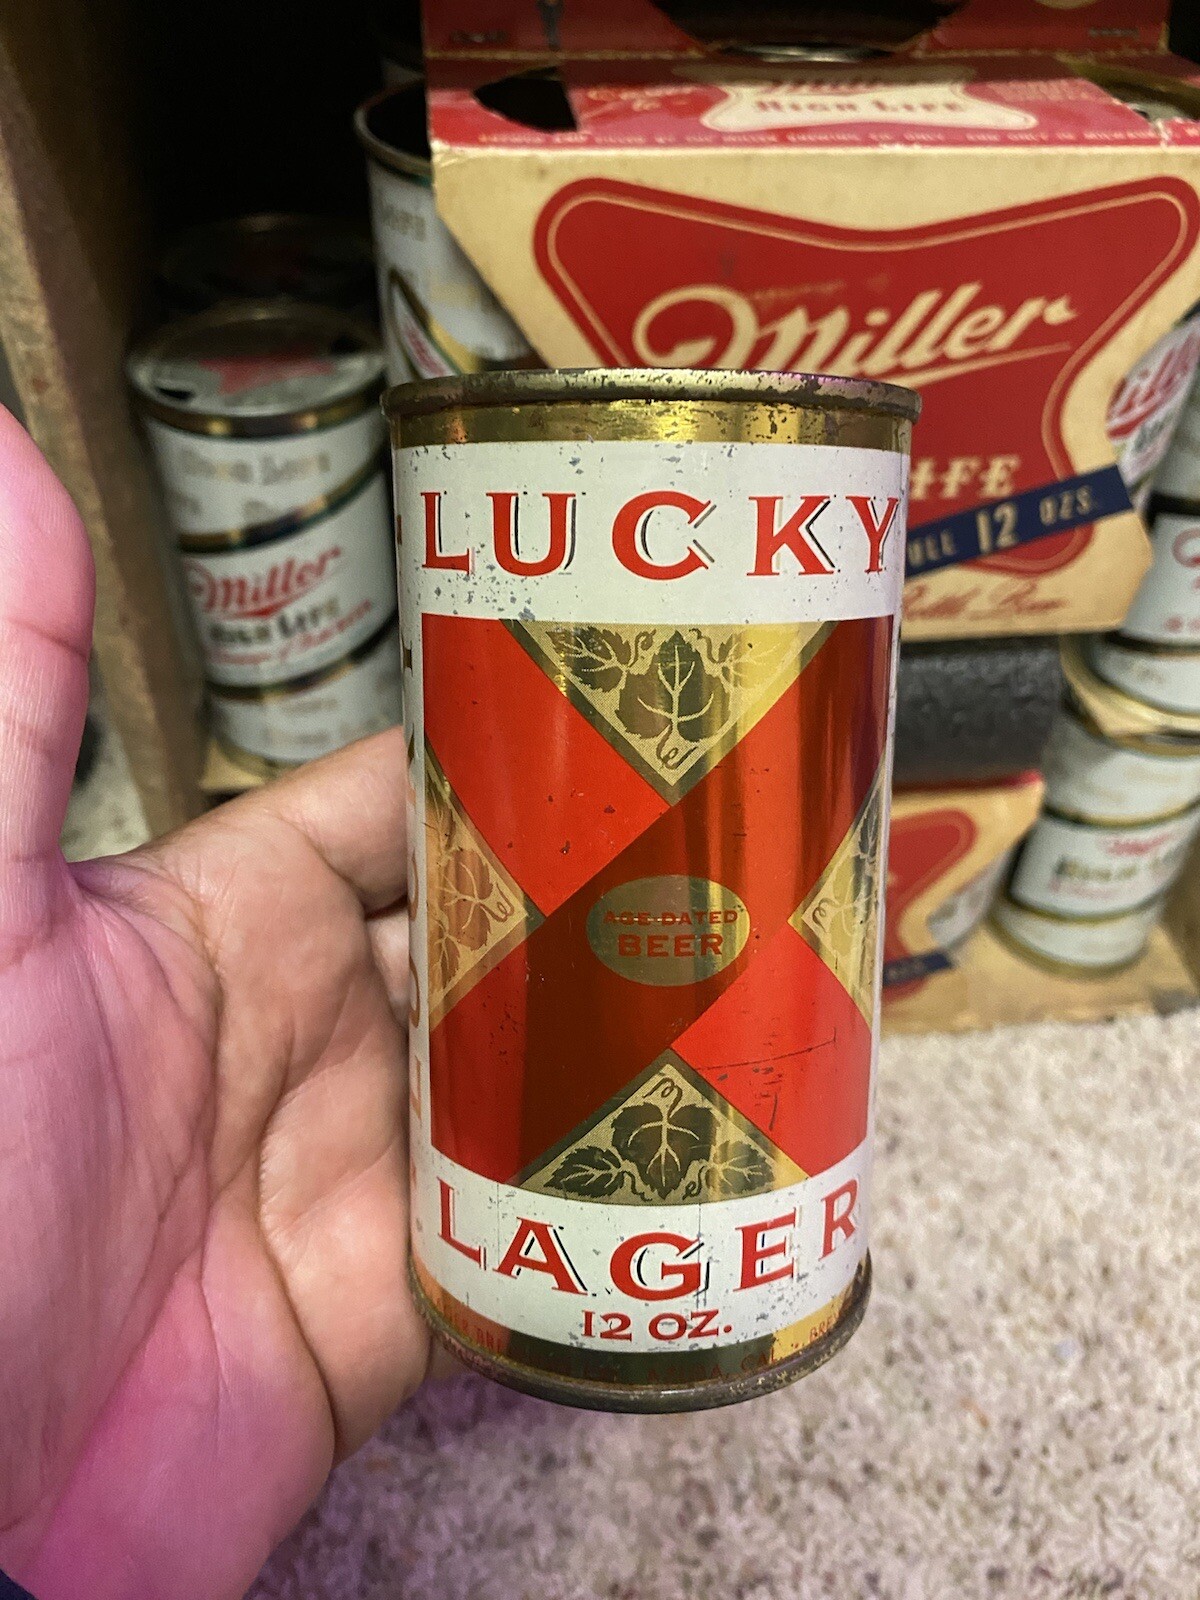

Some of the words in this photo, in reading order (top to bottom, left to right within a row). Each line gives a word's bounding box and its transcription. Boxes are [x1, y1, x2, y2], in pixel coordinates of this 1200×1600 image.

[632, 281, 1078, 378] Miller
[419, 489, 900, 580] LUCKY
[907, 531, 956, 567] ULL
[975, 501, 1019, 555] 12
[603, 909, 739, 927] AGE-DATED
[617, 932, 724, 958] BEER
[434, 1176, 860, 1301] LAGER
[579, 1309, 633, 1343] 12
[647, 1308, 734, 1342] OZ.
